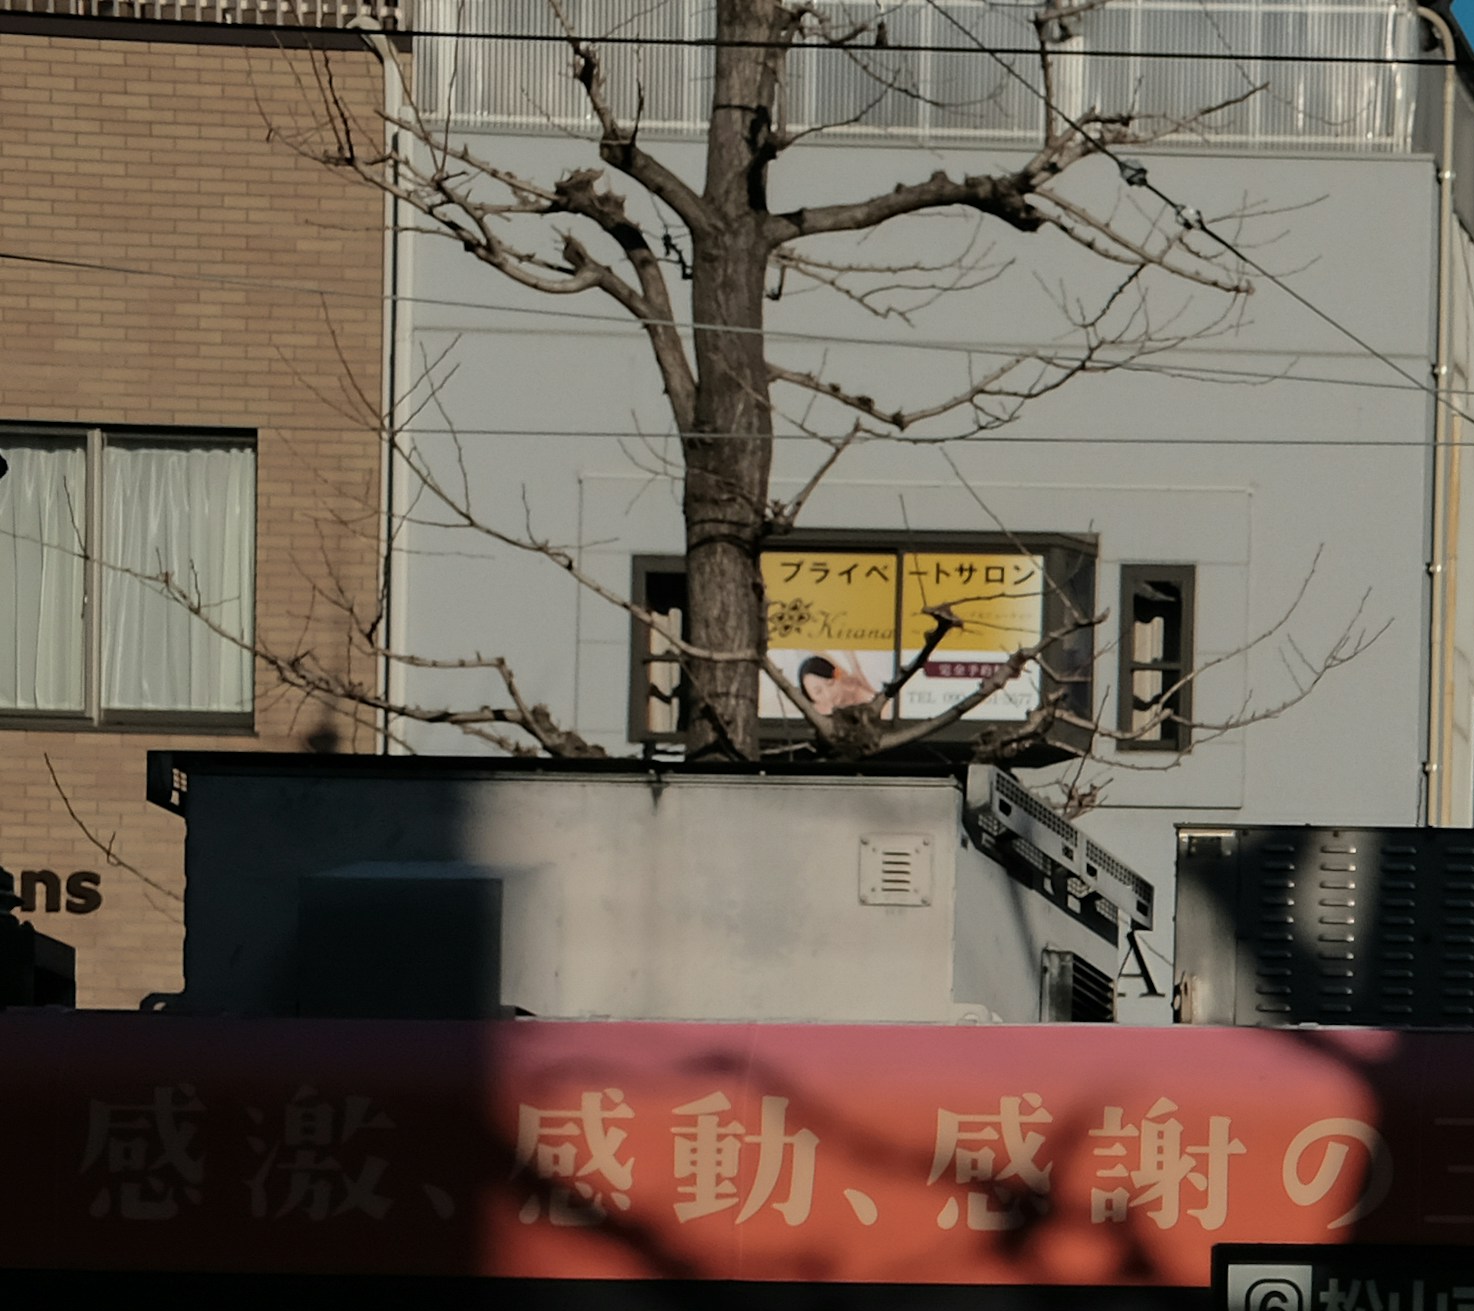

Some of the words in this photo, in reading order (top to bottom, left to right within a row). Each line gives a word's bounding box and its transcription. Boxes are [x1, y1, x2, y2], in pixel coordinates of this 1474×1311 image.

[780, 560, 1036, 585] プライベートサロン
